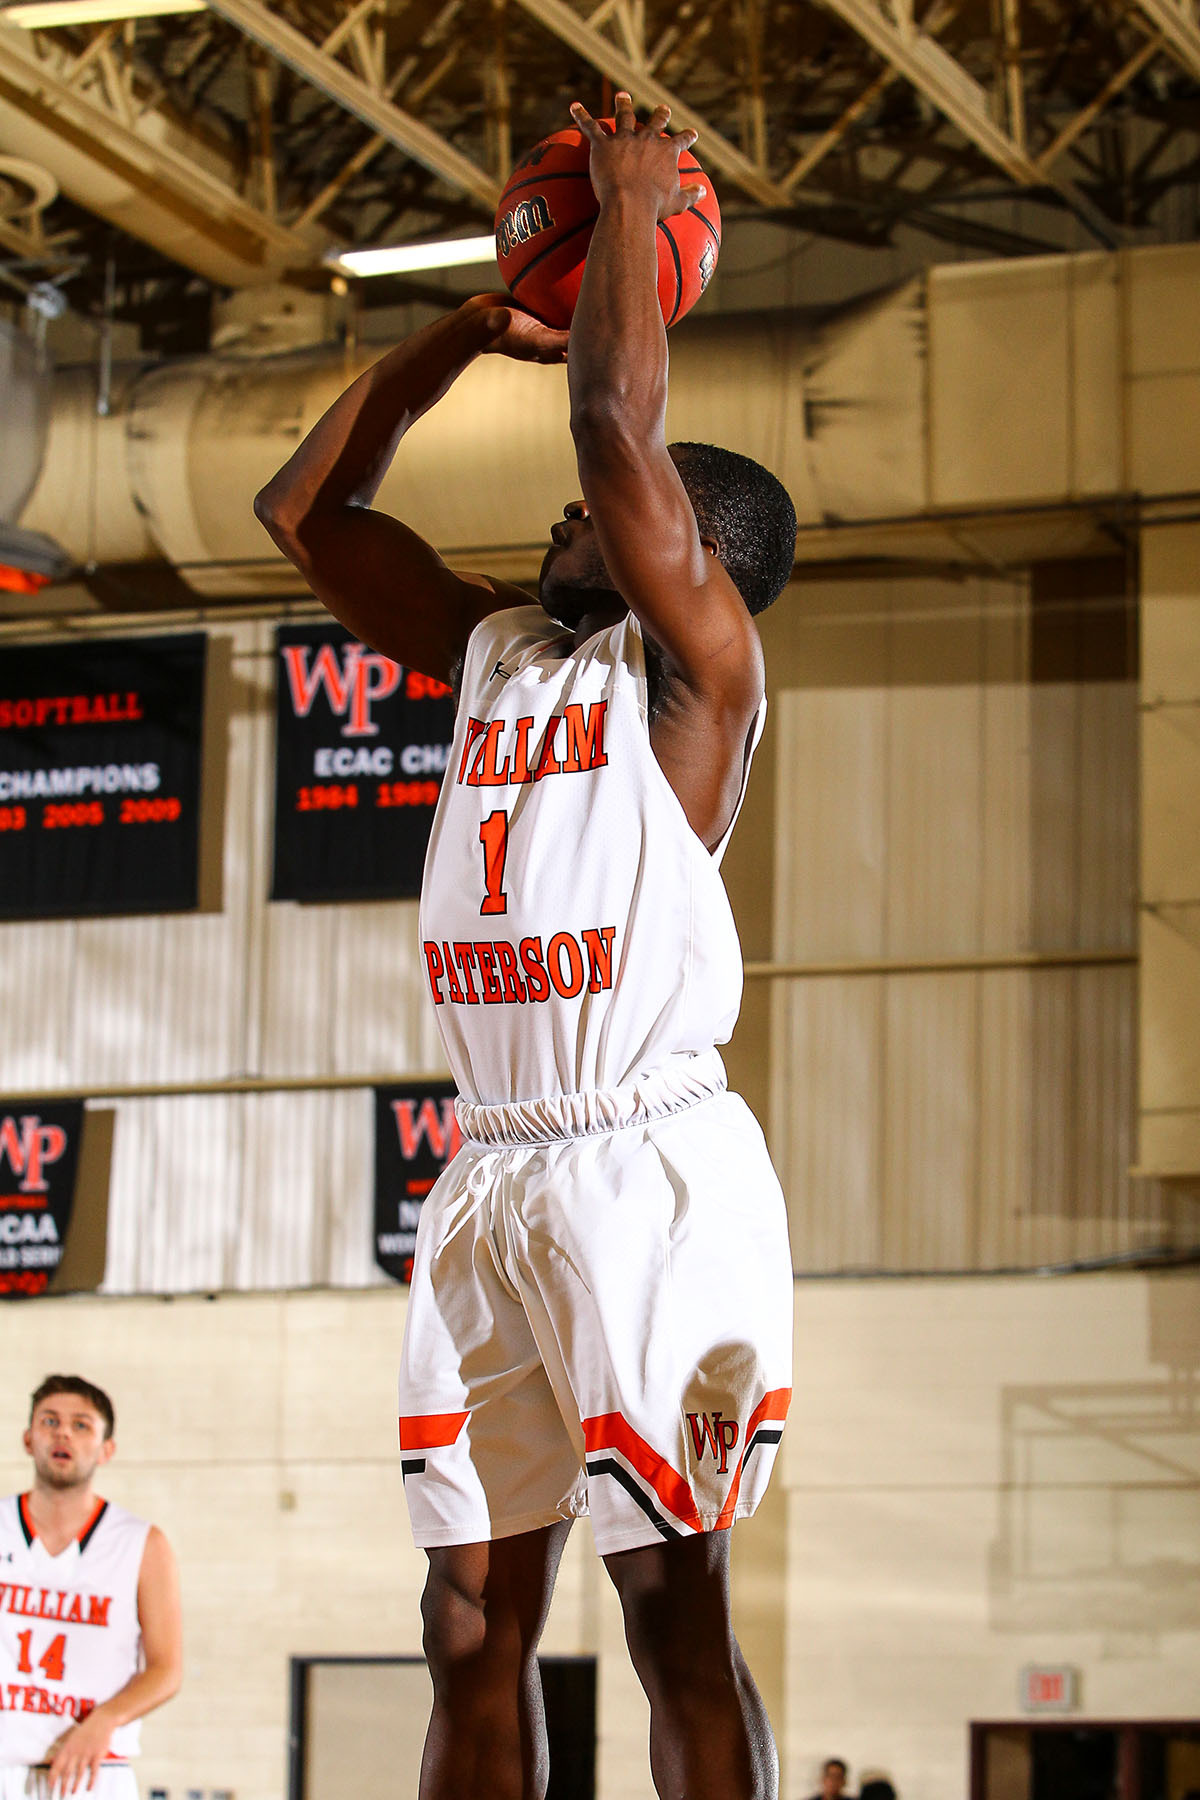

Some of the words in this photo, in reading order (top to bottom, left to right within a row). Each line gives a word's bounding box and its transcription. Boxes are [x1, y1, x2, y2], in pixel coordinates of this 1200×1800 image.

[0, 692, 143, 728] SOFTBALL
[281, 643, 402, 736] WP
[313, 747, 394, 777] ECAC
[479, 810, 508, 916] 1
[423, 926, 616, 1005] PATERSON
[0, 1213, 59, 1245] CAA
[686, 1412, 739, 1475] WP
[17, 1628, 67, 1681] 14
